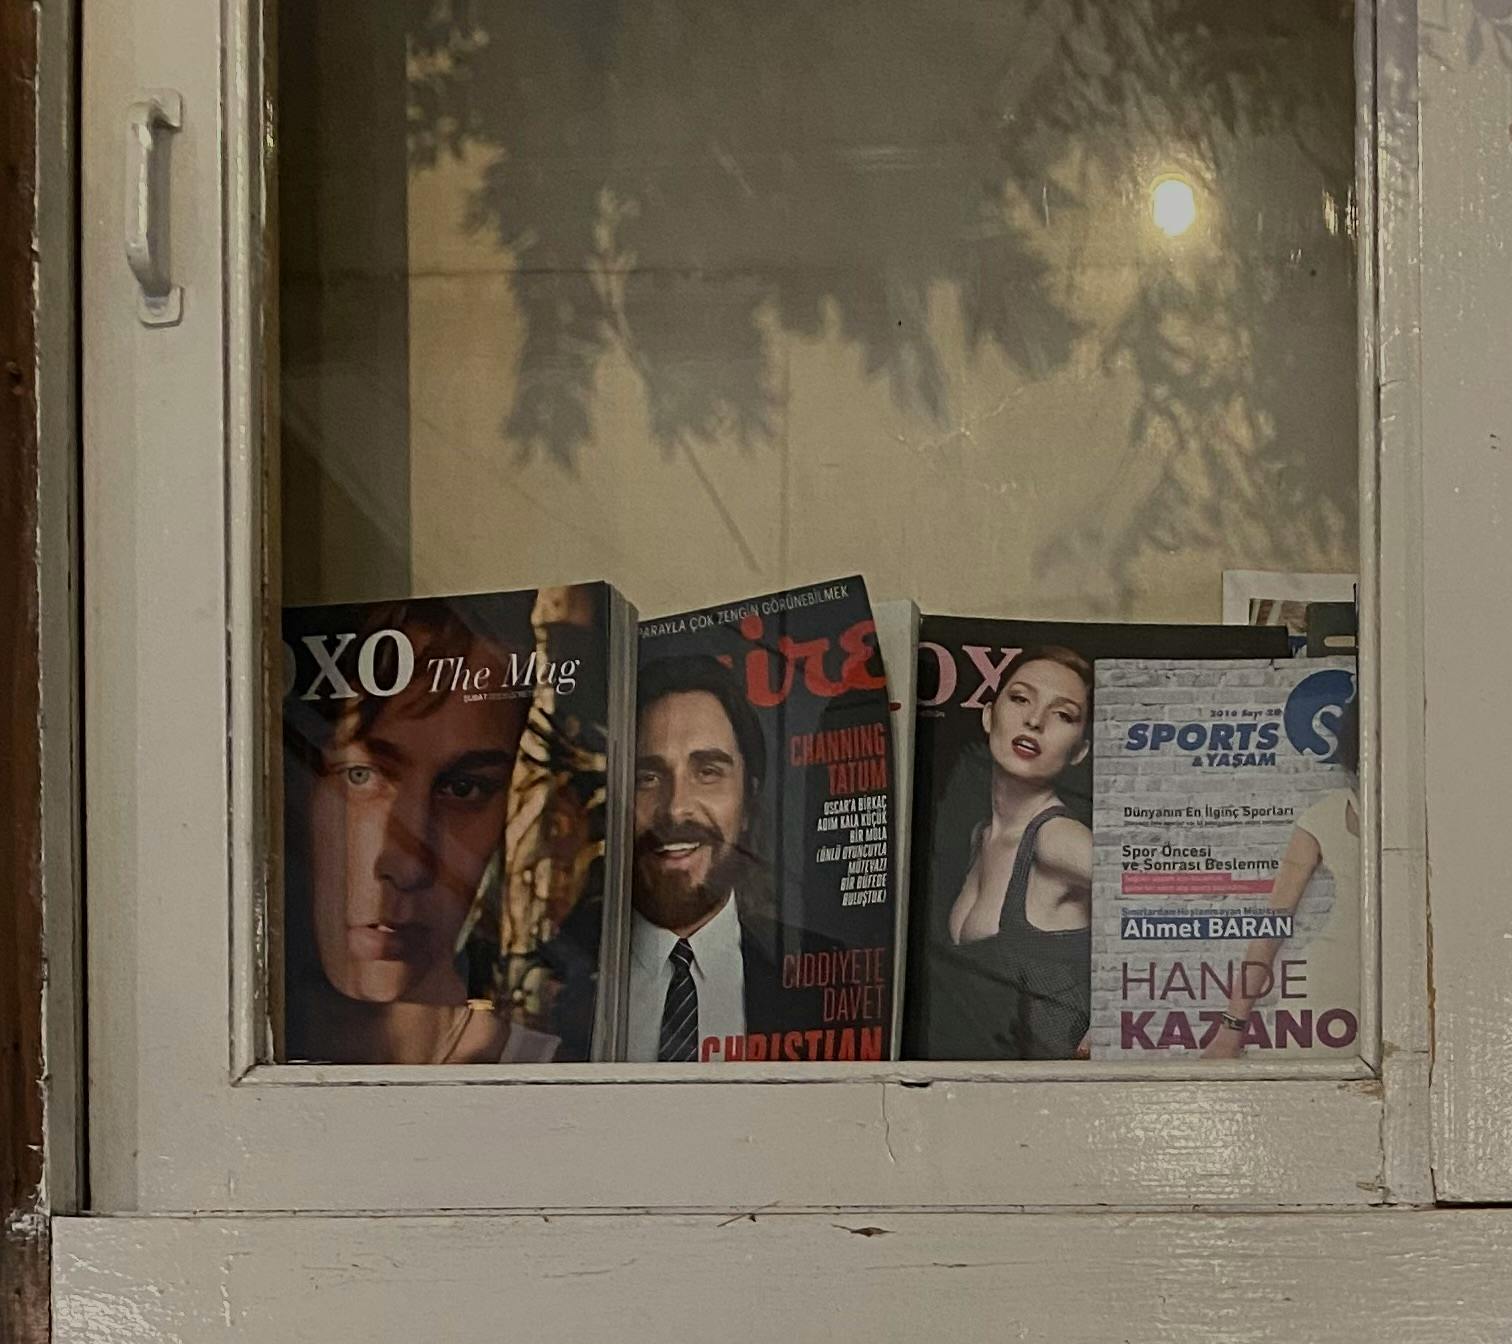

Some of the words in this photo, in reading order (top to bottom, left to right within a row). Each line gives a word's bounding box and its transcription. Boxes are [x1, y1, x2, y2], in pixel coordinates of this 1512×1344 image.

[689, 614, 714, 635] ÇOK
[761, 584, 849, 615] GÖRÜNEBİLMEK
[428, 653, 491, 695] The
[501, 652, 582, 696] Mag
[789, 722, 887, 768] CHANNING
[1125, 722, 1281, 751] SPORTS
[828, 757, 888, 797] TATUM
[1205, 752, 1277, 769] YAŞAM
[1123, 806, 1183, 821] Dünyanın
[1185, 806, 1202, 818] En
[1205, 804, 1240, 820] İlginç
[1242, 806, 1294, 821] Sporları
[1122, 844, 1158, 860] Spor
[1161, 841, 1212, 858] Öncesi
[1122, 861, 1139, 871] ve
[1141, 859, 1201, 872] Sonrası
[1204, 858, 1280, 871] Beslenme
[1122, 918, 1202, 938] Ahmet
[1208, 917, 1293, 937] BARAN
[781, 945, 887, 991] CİDDİYETE
[1121, 959, 1308, 1002] HANDE
[822, 987, 886, 1025] DAVET
[701, 1026, 883, 1062] CHRISTIAN
